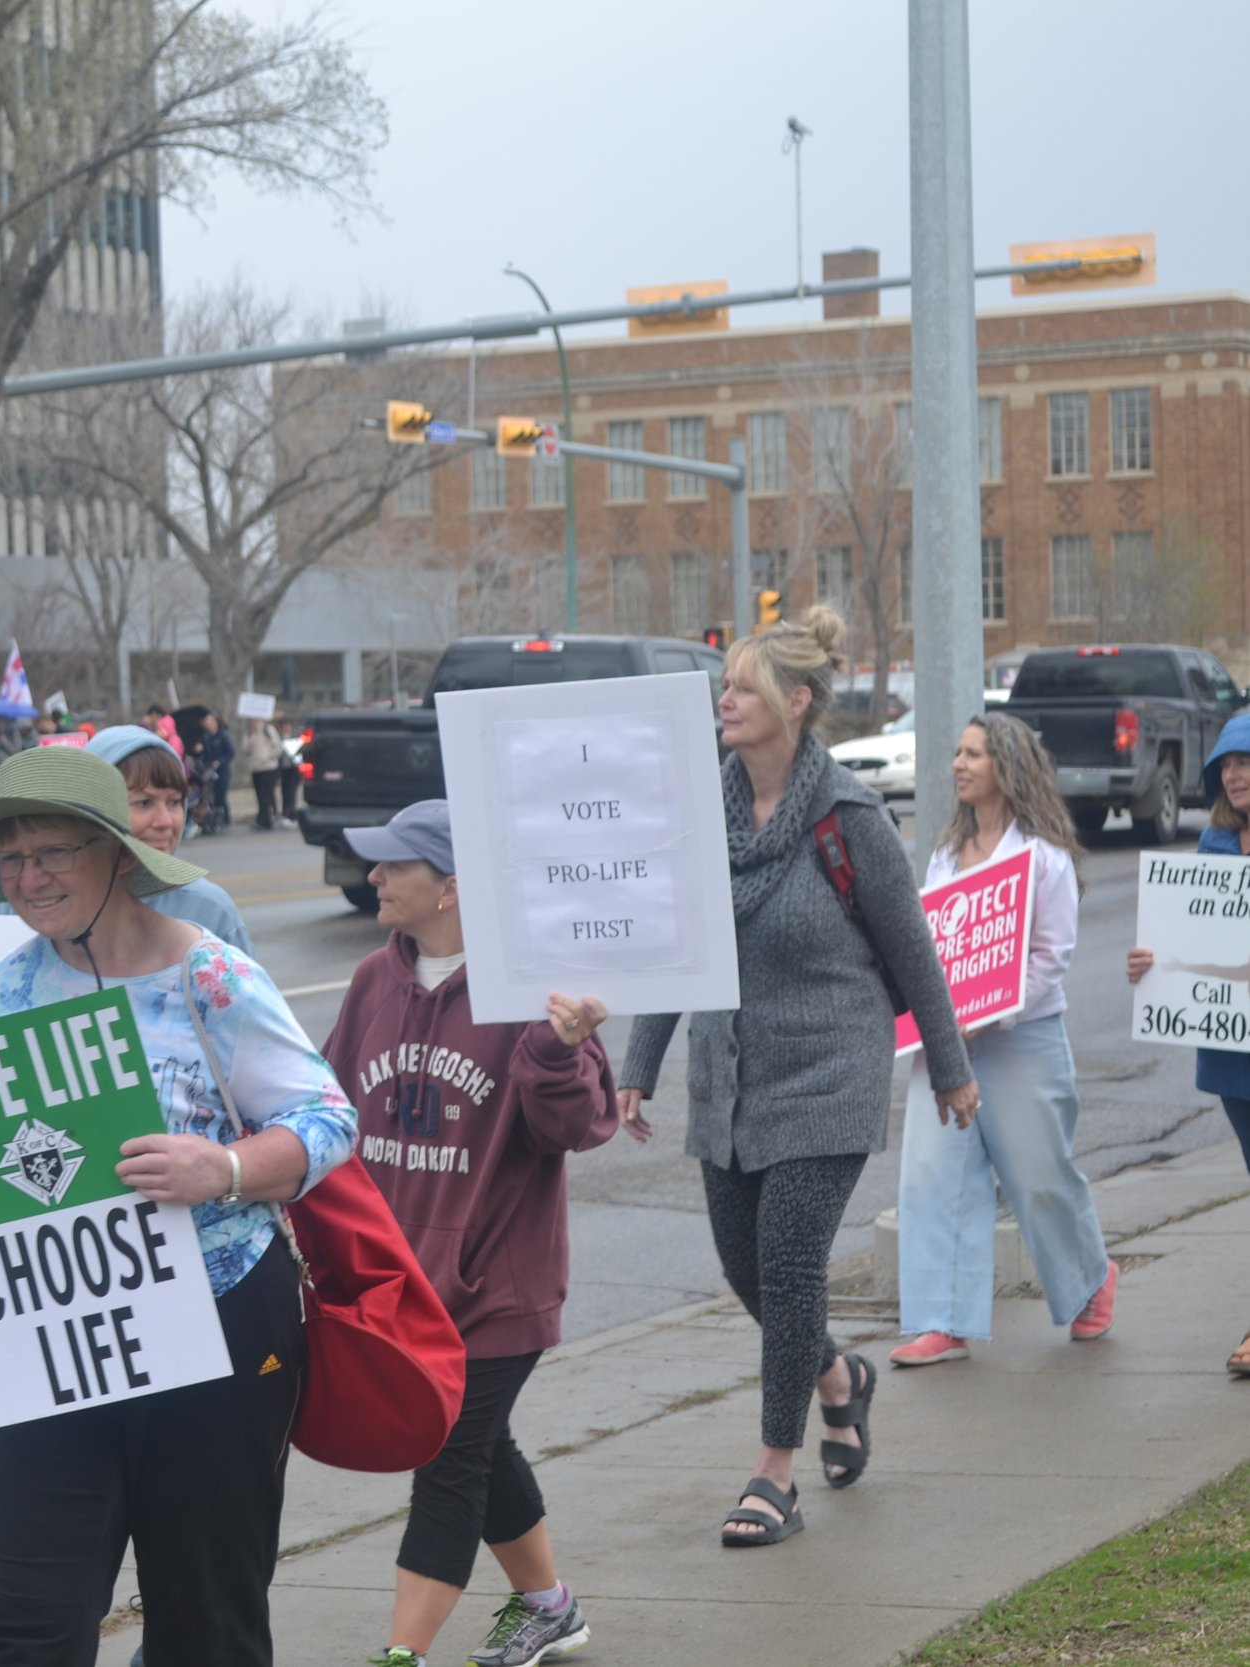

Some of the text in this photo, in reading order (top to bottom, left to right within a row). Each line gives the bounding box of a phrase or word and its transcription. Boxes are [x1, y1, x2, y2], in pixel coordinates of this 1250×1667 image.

[581, 744, 588, 762] I
[562, 800, 622, 821] VOTE
[547, 859, 648, 884] PRO-LIFE
[1148, 860, 1232, 894] Hurting
[1188, 896, 1216, 918] an
[572, 918, 634, 940] FIRST
[936, 909, 1018, 962] PRE-BORN
[950, 937, 1016, 986] RIGHTS!
[1192, 981, 1232, 1006] Call
[23, 1005, 140, 1108] LIFE
[17, 1140, 30, 1155] K
[45, 1134, 57, 1148] C
[407, 1144, 469, 1174] DAKOTA
[36, 1305, 152, 1406] LIFE
